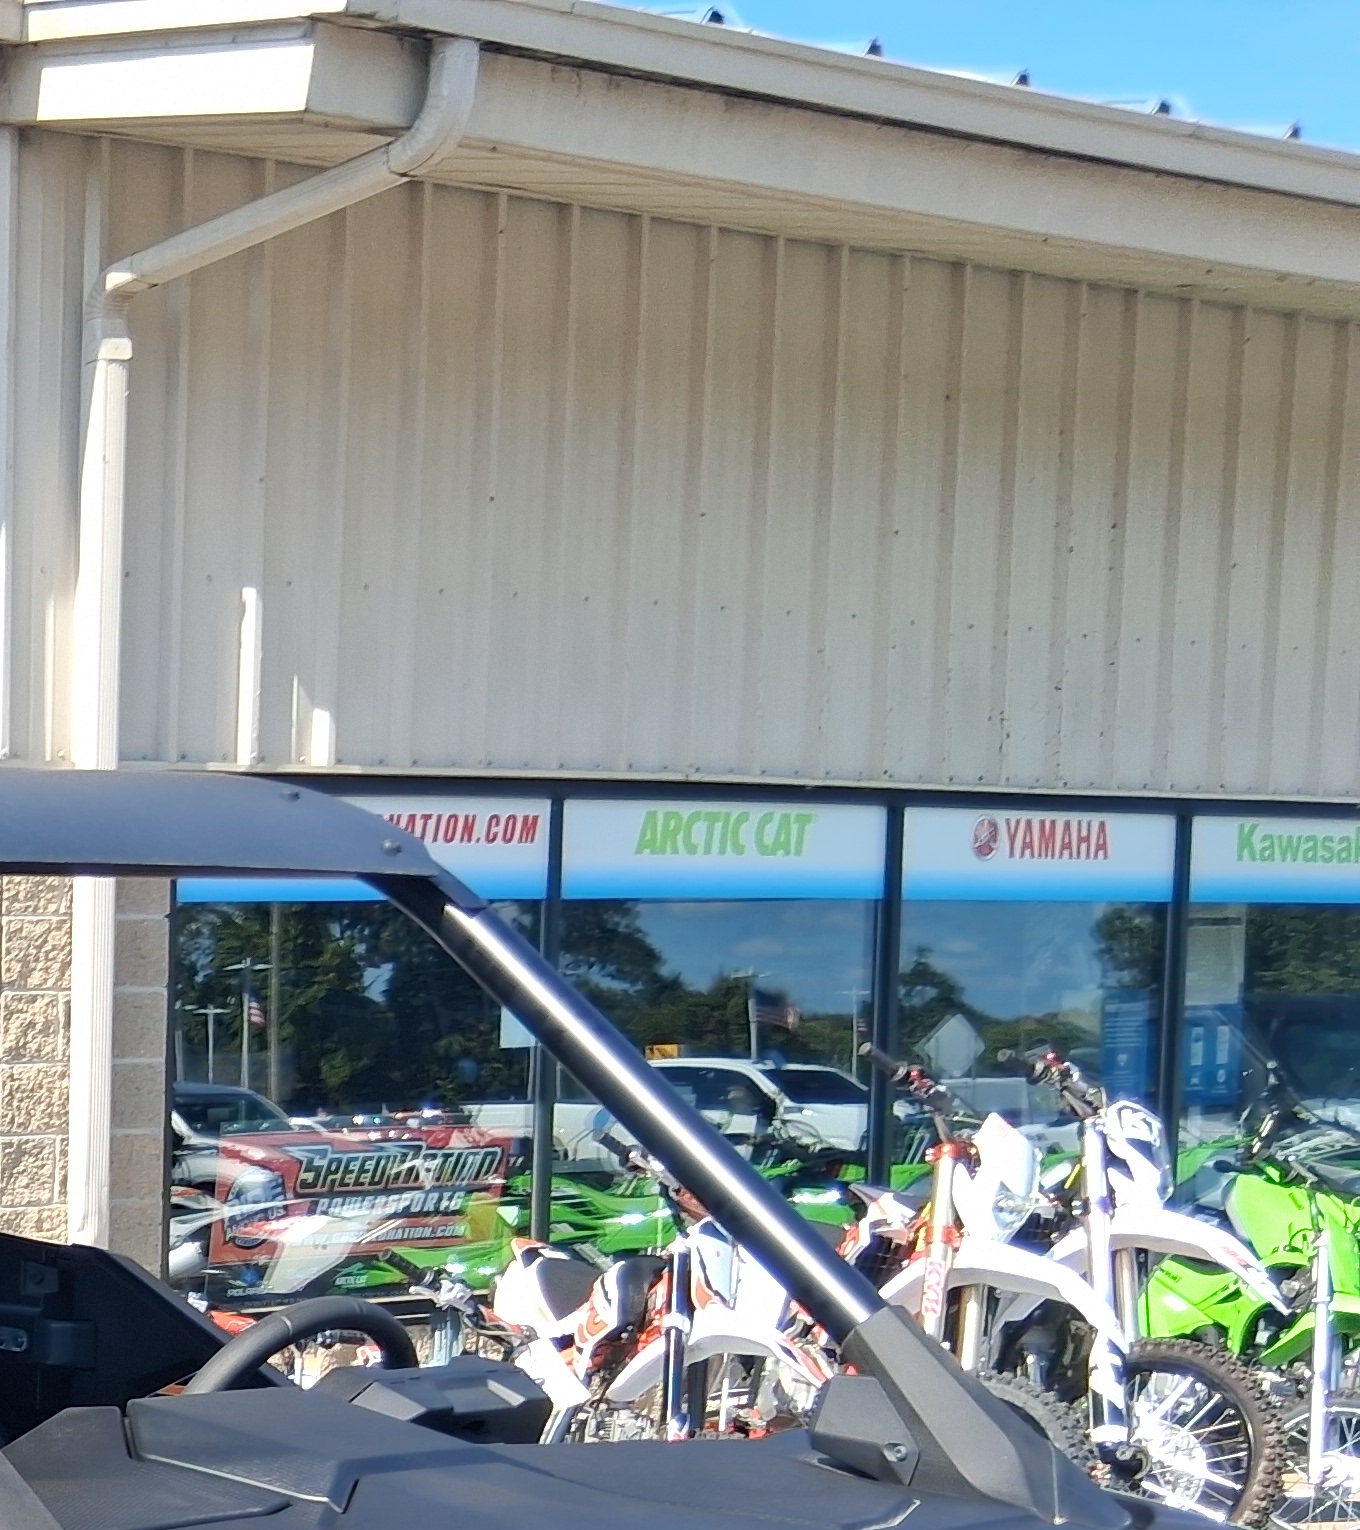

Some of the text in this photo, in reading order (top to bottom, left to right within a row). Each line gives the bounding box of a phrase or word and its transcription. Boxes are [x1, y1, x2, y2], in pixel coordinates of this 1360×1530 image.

[635, 810, 818, 858] ARCTIC CAT
[1005, 816, 1111, 861] YAMAHA
